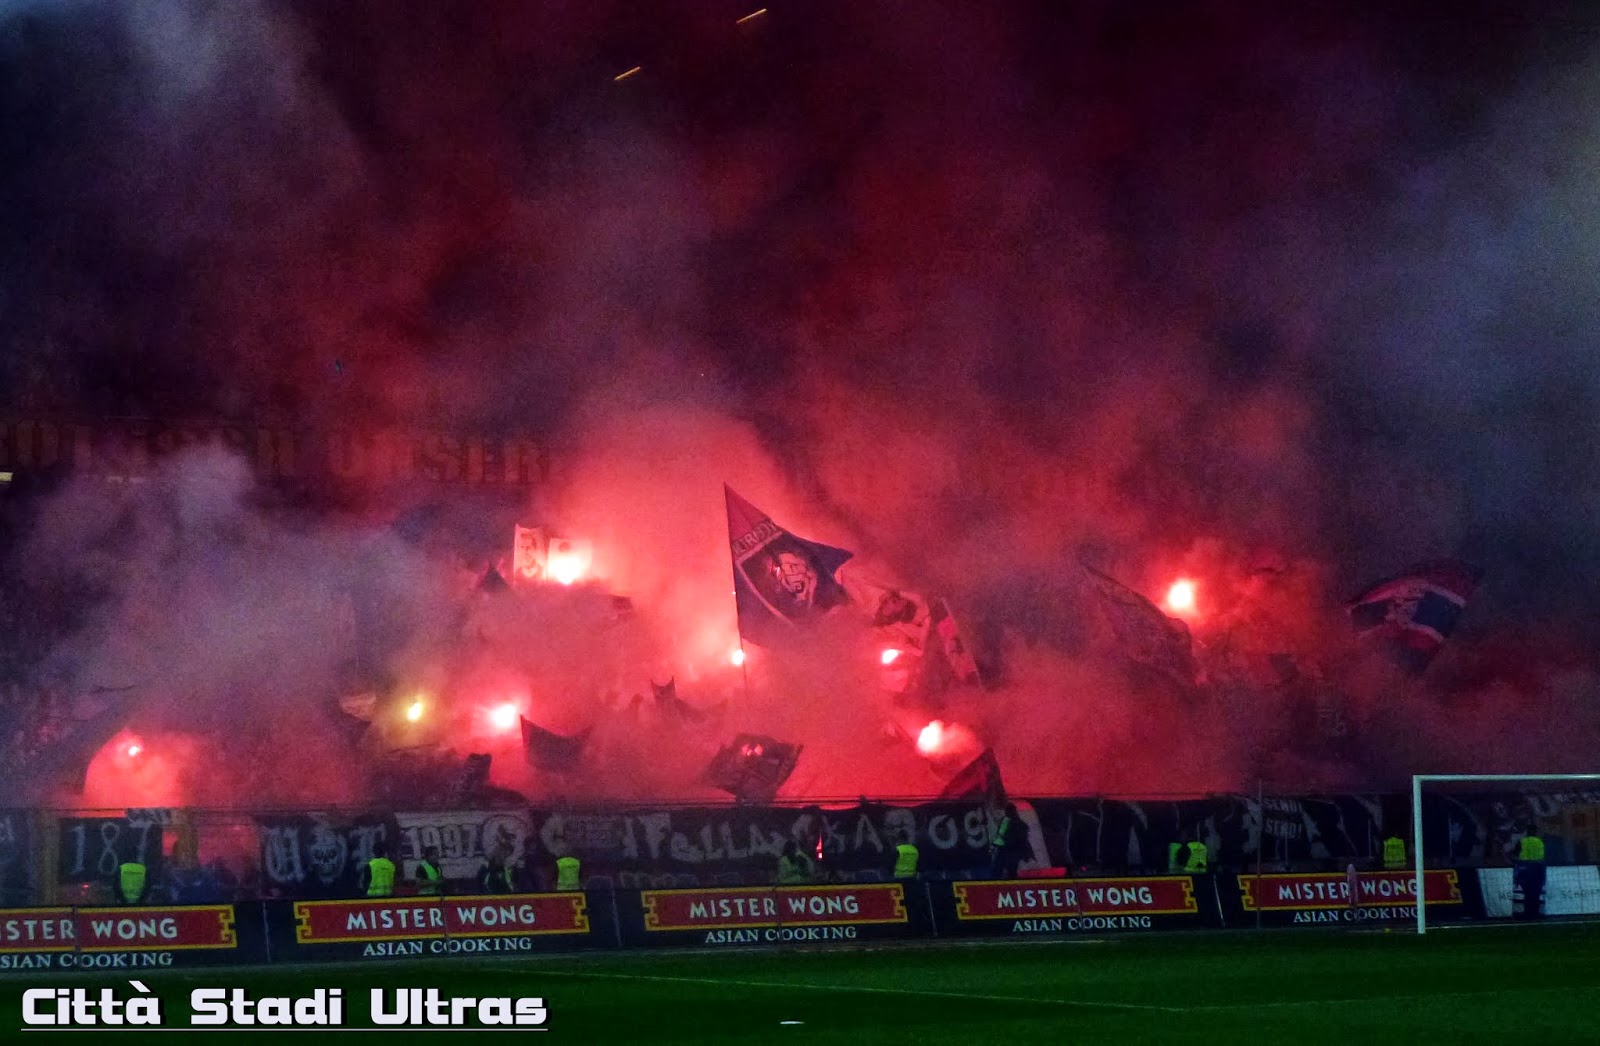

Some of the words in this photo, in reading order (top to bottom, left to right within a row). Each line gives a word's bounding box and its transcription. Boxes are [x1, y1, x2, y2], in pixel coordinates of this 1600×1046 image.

[997, 888, 1077, 908] MISTER
[1087, 886, 1153, 906] WONG
[1278, 882, 1350, 900] MISTER
[1361, 878, 1418, 897] WONG
[346, 908, 443, 931] MISTER
[457, 904, 536, 925] WONG
[689, 897, 776, 919] MISTER
[788, 895, 859, 915] WONG
[1293, 910, 1339, 923] ASIAN
[0, 919, 75, 941] STER
[91, 917, 178, 940] WONG
[704, 929, 759, 944] ASIAN
[765, 925, 857, 942] COOKING
[1012, 918, 1063, 933] ASIAN
[1068, 915, 1151, 931] COOKING
[362, 940, 423, 957] ASIAN
[430, 937, 532, 954] COOKING
[59, 952, 174, 968] COOKING
